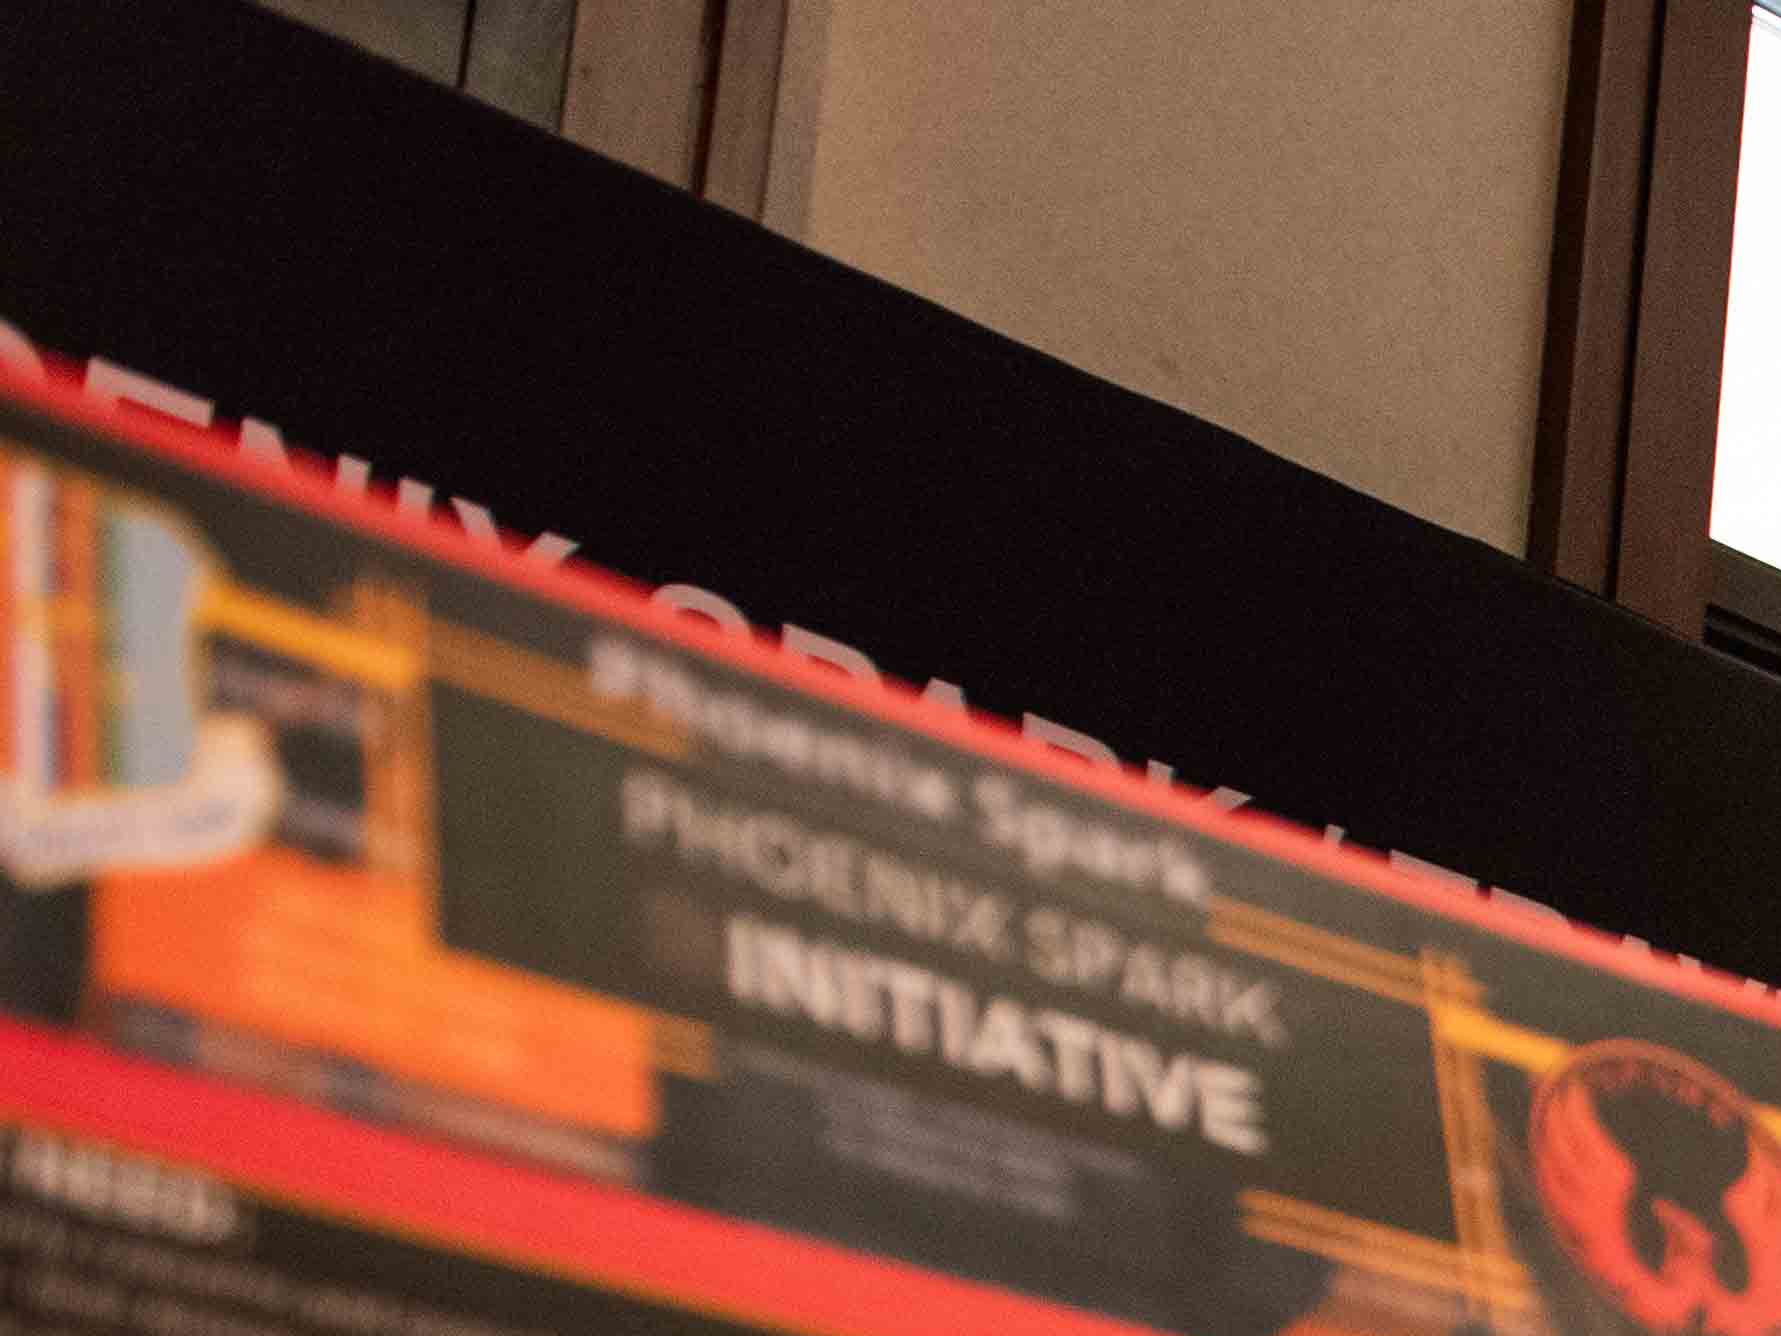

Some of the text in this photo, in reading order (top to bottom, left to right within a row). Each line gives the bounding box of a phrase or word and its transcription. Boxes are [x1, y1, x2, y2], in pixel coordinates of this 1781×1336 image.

[620, 769, 1288, 1047] PHOENIX SPARK
[724, 910, 1272, 1157] INITIATIVE
